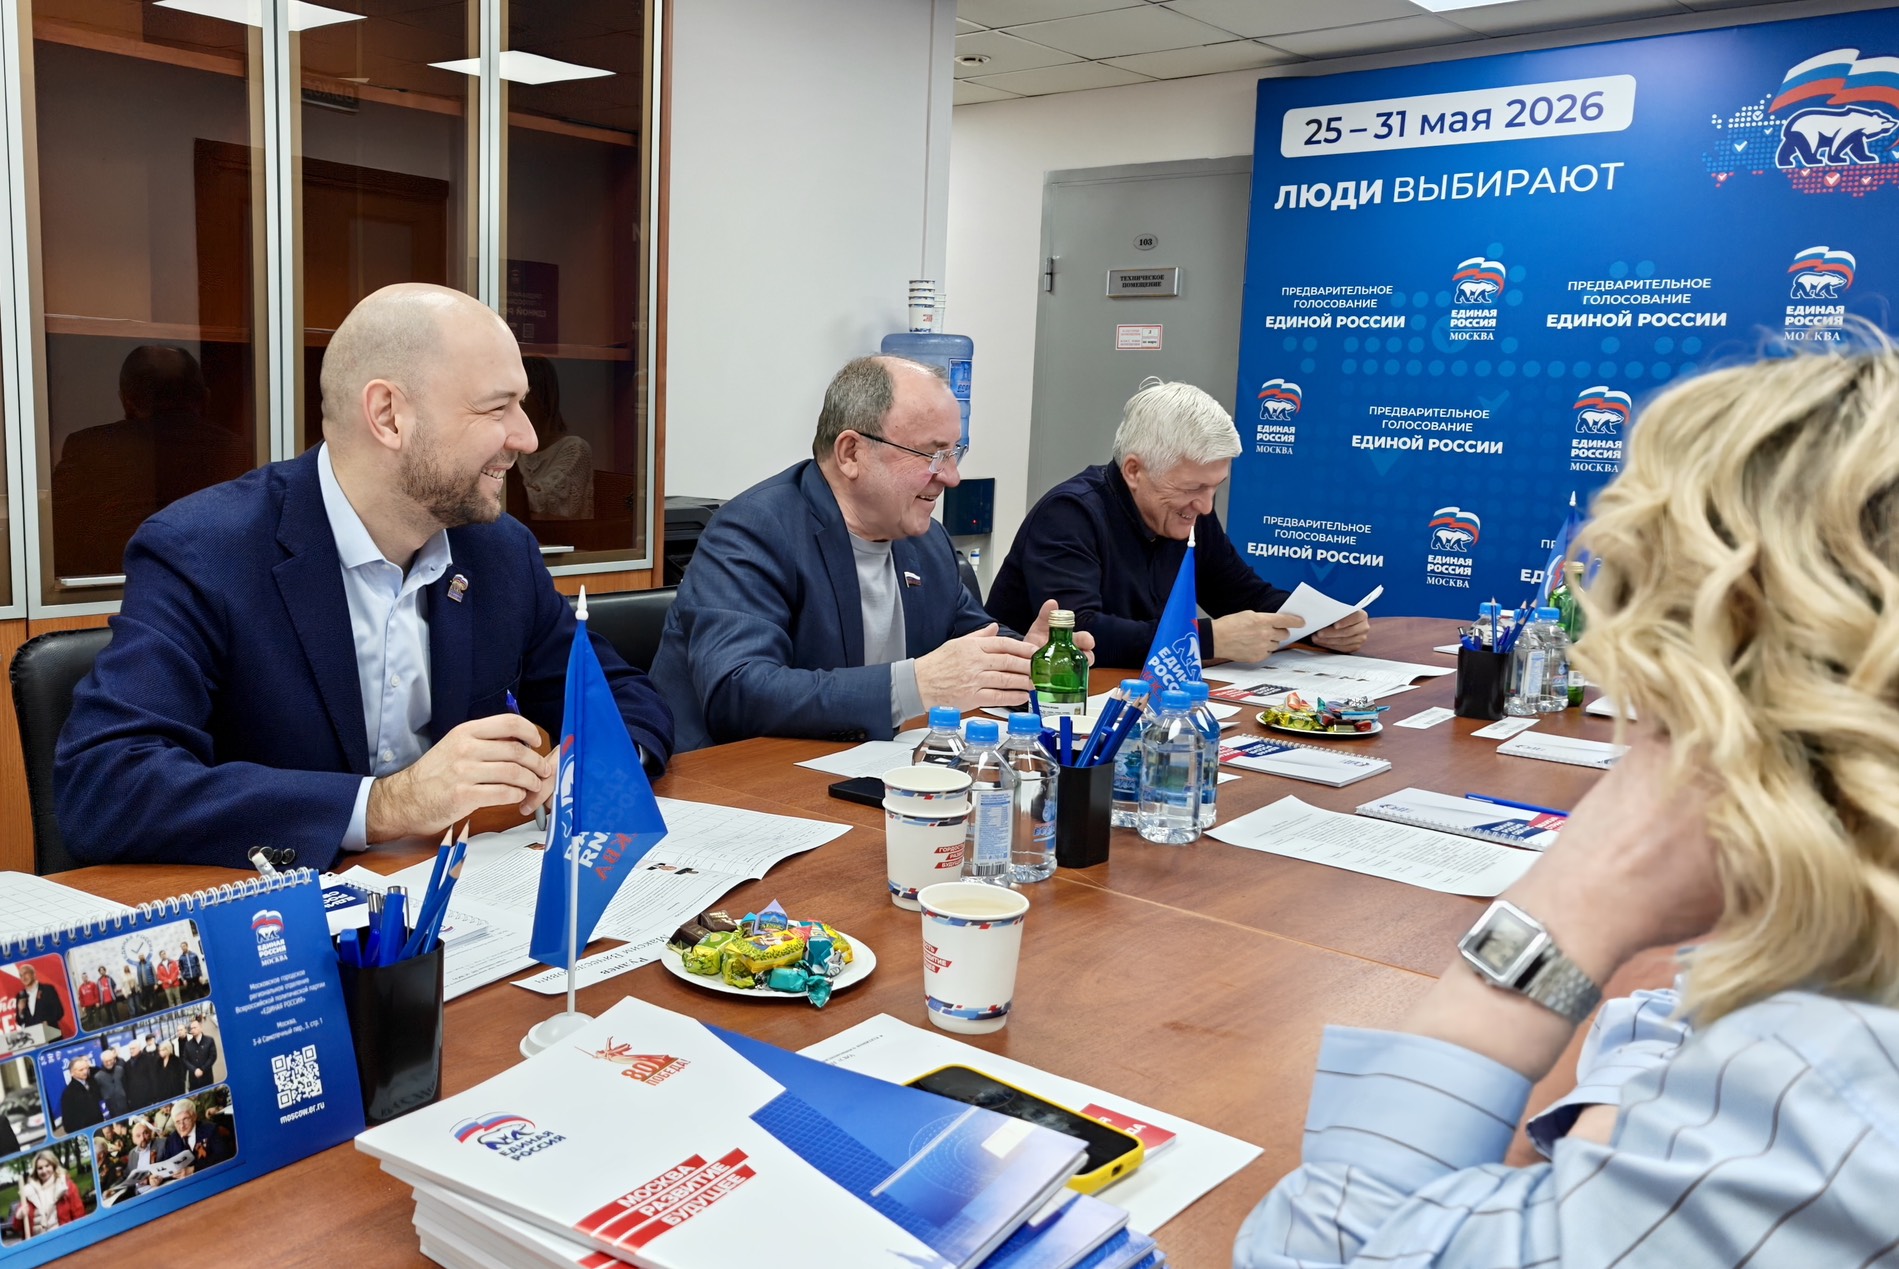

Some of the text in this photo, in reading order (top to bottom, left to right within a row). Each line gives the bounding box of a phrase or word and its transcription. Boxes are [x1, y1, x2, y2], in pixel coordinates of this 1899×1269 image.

[1420, 111, 1491, 132] мая
[1505, 91, 1604, 127] 2026
[1274, 162, 1625, 212] ЛЮДИ ВЫБИРАЮТ
[1139, 238, 1153, 246] 103
[1282, 286, 1393, 296] ПРЕДВАРИТЕЛЬНОЕ
[1568, 279, 1711, 291] ПРЕДВАРИТЕЛЬНОЕ
[1294, 299, 1377, 308] ГОЛОСОВАНИЕ
[1583, 294, 1691, 304] ГОЛОСОВАНИЕ
[1451, 309, 1497, 320] ЕДИНАЯ
[1786, 305, 1845, 315] ЕДИНАЯ
[1266, 313, 1405, 329] ЕДИНОЙ РОССИИ
[1451, 317, 1496, 327] РОССИЯ
[1547, 310, 1727, 329] ЕДИНОЙ РОССИИ
[1785, 315, 1843, 326] РОССИЯ
[1450, 332, 1493, 340] МОСКВА
[1370, 407, 1489, 421] ПРЕДВАРИТЕЛЬНОЕ
[1257, 425, 1295, 436] ЕДИНАЯ
[1383, 420, 1473, 431] ГОЛОСОВАНИЕ
[1257, 432, 1295, 444] РОССИЯ
[1256, 445, 1292, 454] МОСКВА
[1352, 435, 1503, 454] ЕДИНОЙ РОССИИ
[1572, 439, 1624, 451] ЕДИНАЯ
[1571, 448, 1623, 460] РОССИЯ
[1570, 463, 1619, 473] МОСКВА
[1264, 516, 1371, 536] ПРЕДВАРИТЕЛЬНОЕ
[1275, 528, 1358, 546] ГОЛОСОВАНИЕ
[1248, 540, 1383, 567] ЕДИНОЙ РОССИИ
[1427, 555, 1472, 568] ЕДИНАЯ
[1427, 563, 1472, 577] РОССИЯ
[1427, 576, 1470, 588] МОСКВА
[1148, 656, 1180, 692] РОСС
[257, 939, 285, 951] ЕДИНАЯ
[259, 945, 287, 957] РОССИЯ
[261, 954, 288, 966] МОСКВА
[647, 1058, 691, 1086] ПОБЕДА!
[280, 1102, 325, 1123] moscow.er.ru
[499, 1131, 554, 1157] ЕДИНАЯ
[511, 1135, 567, 1161] РОССИЯ
[616, 1163, 697, 1207] МОСКВА
[638, 1162, 730, 1216] РАЗВИТИЕ
[661, 1173, 747, 1226] БУДУЩЕЕ
